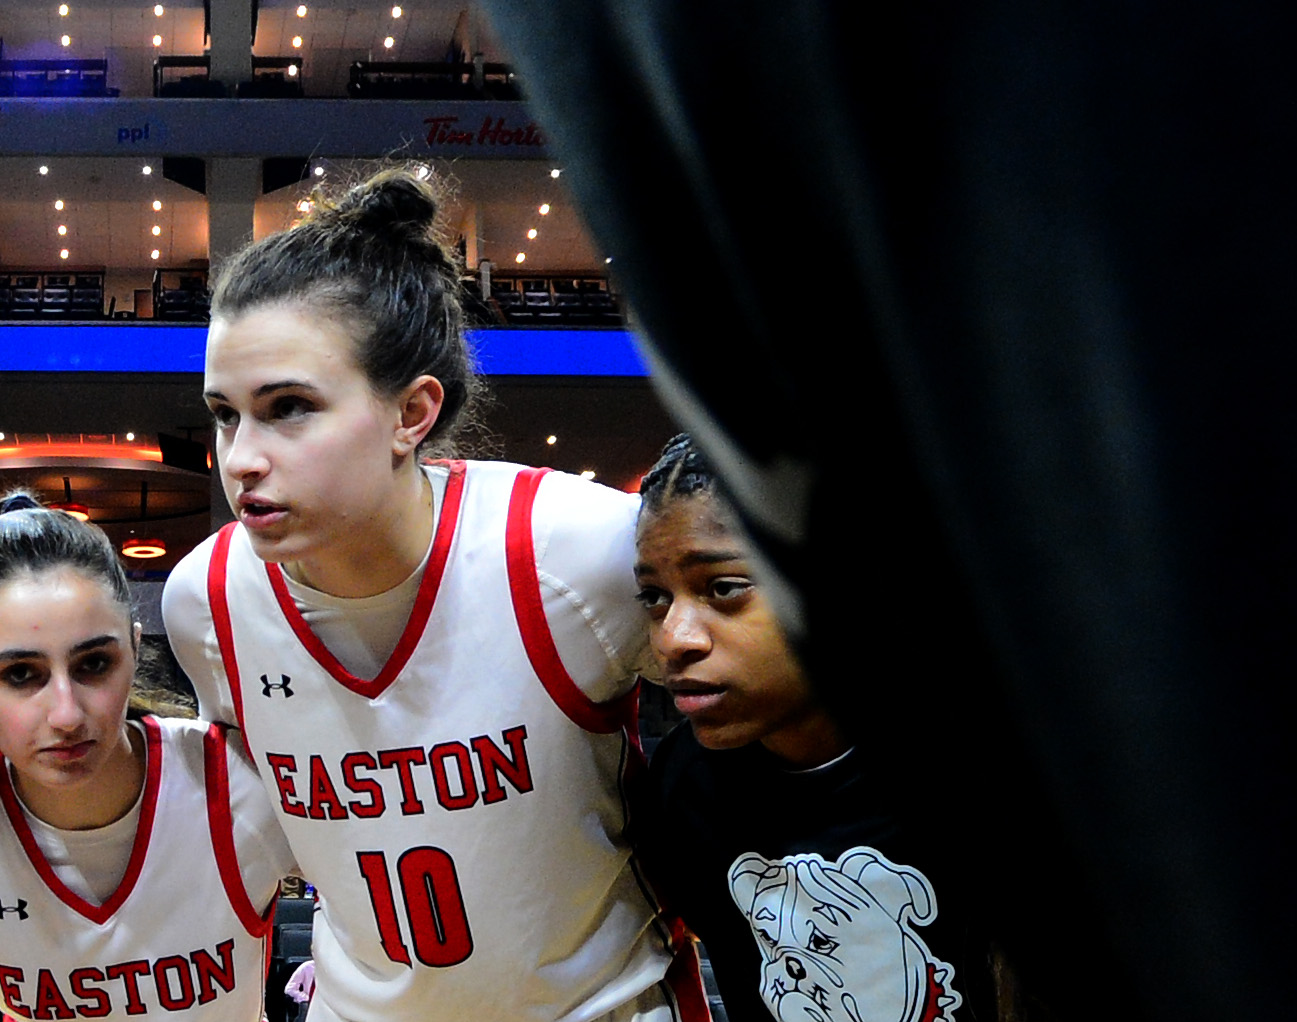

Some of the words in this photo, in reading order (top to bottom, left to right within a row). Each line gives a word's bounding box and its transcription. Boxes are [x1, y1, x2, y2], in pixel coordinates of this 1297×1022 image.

[117, 123, 150, 144] ppl
[424, 115, 473, 146] Tim
[265, 724, 535, 821] EASTON
[355, 845, 474, 970] 10
